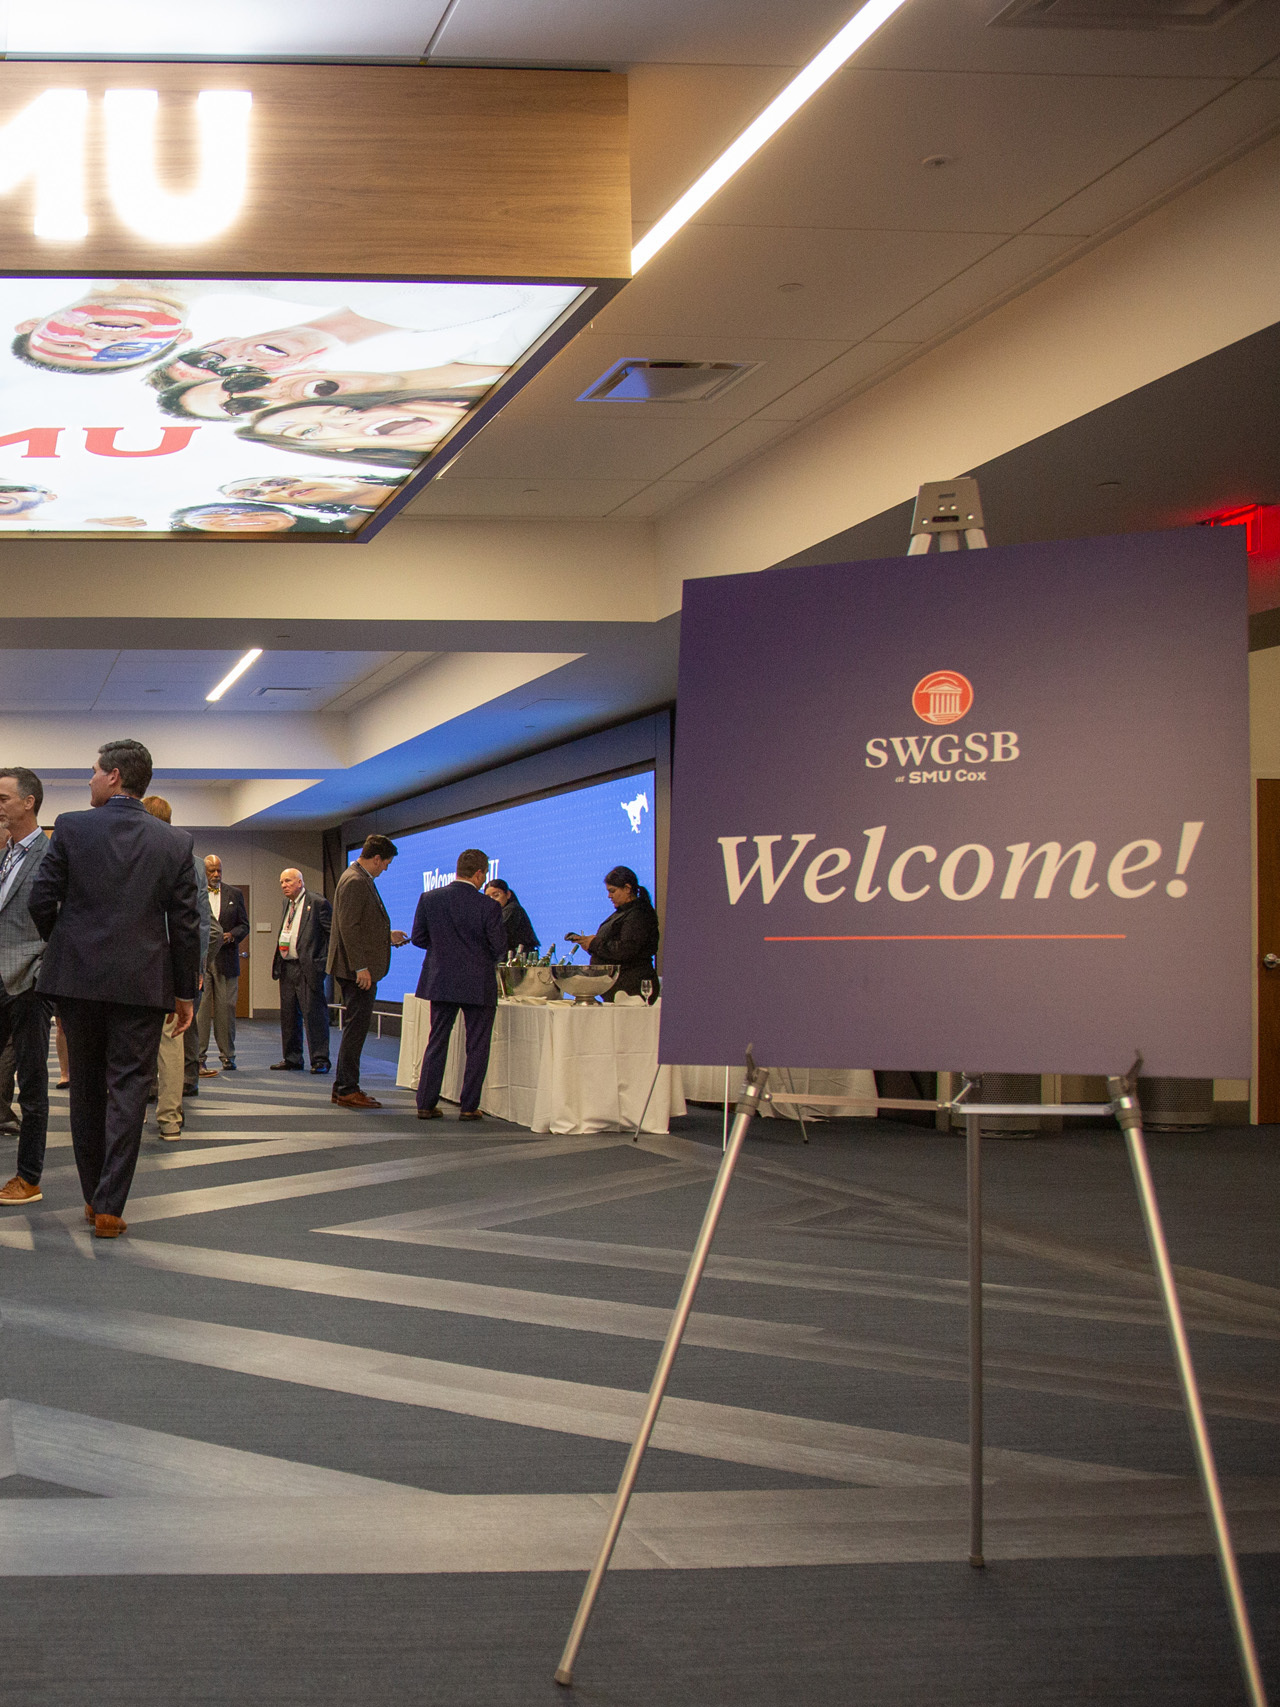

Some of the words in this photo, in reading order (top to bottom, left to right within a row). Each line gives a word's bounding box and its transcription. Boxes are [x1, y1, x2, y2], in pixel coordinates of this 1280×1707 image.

[865, 731, 1020, 769] SWGSB
[895, 775, 906, 784] at
[908, 770, 952, 784] SMU
[954, 769, 987, 782] Cox
[717, 821, 1204, 905] Welcome!
[423, 868, 457, 892] Welcom
